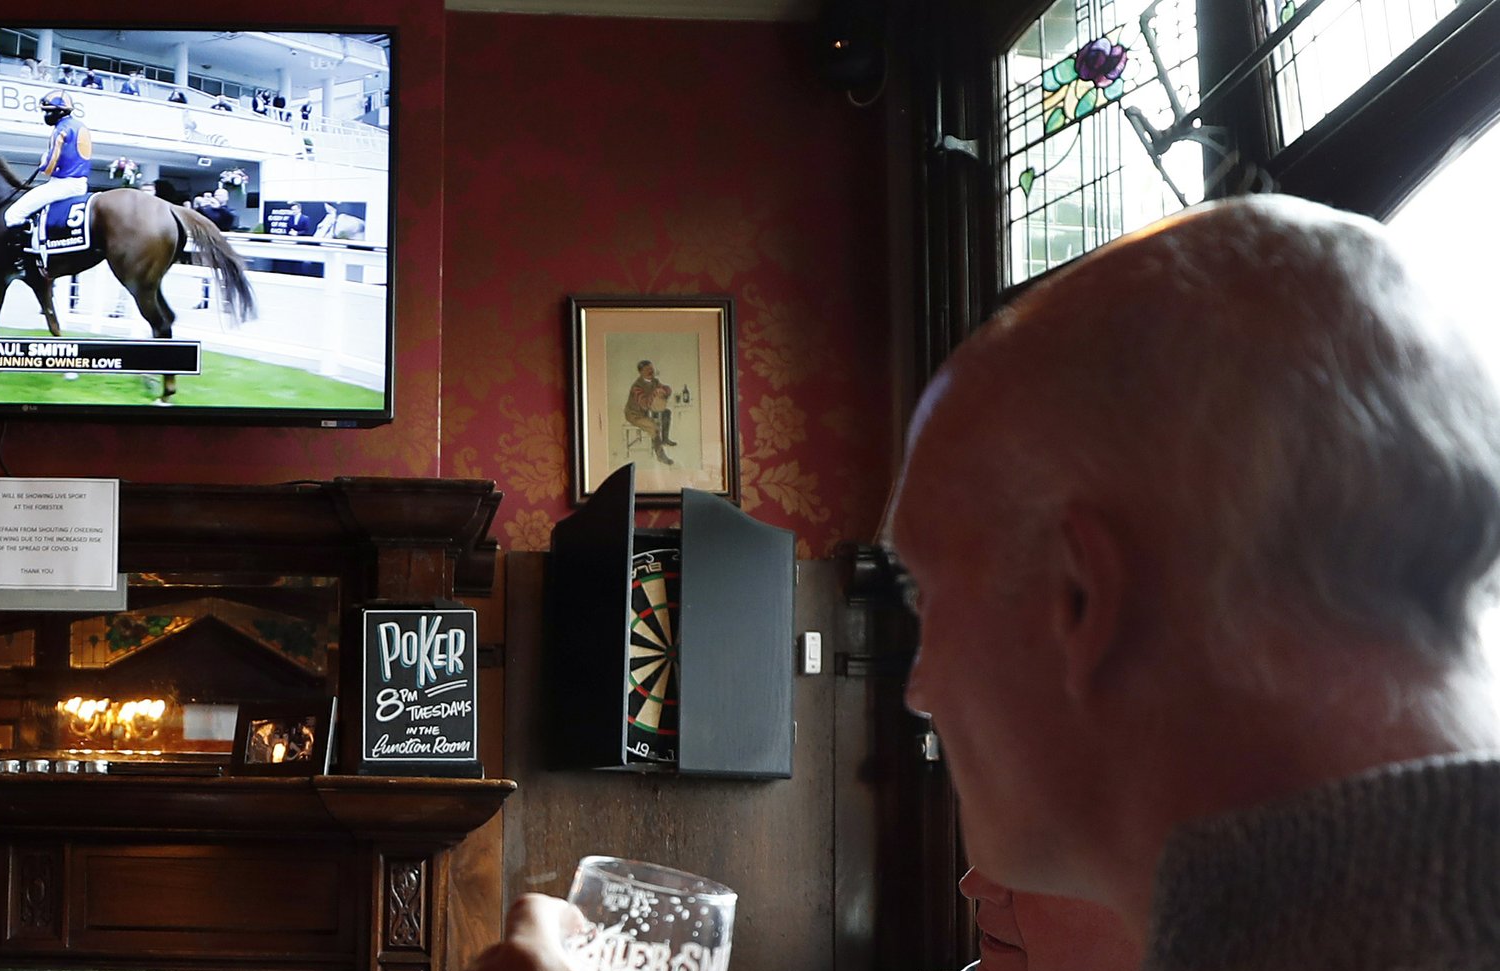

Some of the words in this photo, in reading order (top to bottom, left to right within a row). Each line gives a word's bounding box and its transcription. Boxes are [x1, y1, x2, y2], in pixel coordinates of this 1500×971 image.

[2, 86, 85, 118] Bas
[66, 202, 86, 228] 5
[27, 344, 79, 357] SMITH
[45, 357, 90, 369] OWNER
[91, 358, 122, 369] LOVE
[19, 526, 38, 534] FROM
[38, 526, 68, 534] SHOUTING
[20, 535, 32, 543] DUE
[34, 535, 42, 543] TO
[55, 535, 88, 543] INCREASED
[405, 700, 472, 721] TUESDAYS
[406, 726, 417, 735] IN
[419, 726, 441, 735] THE
[432, 736, 471, 754] Room
